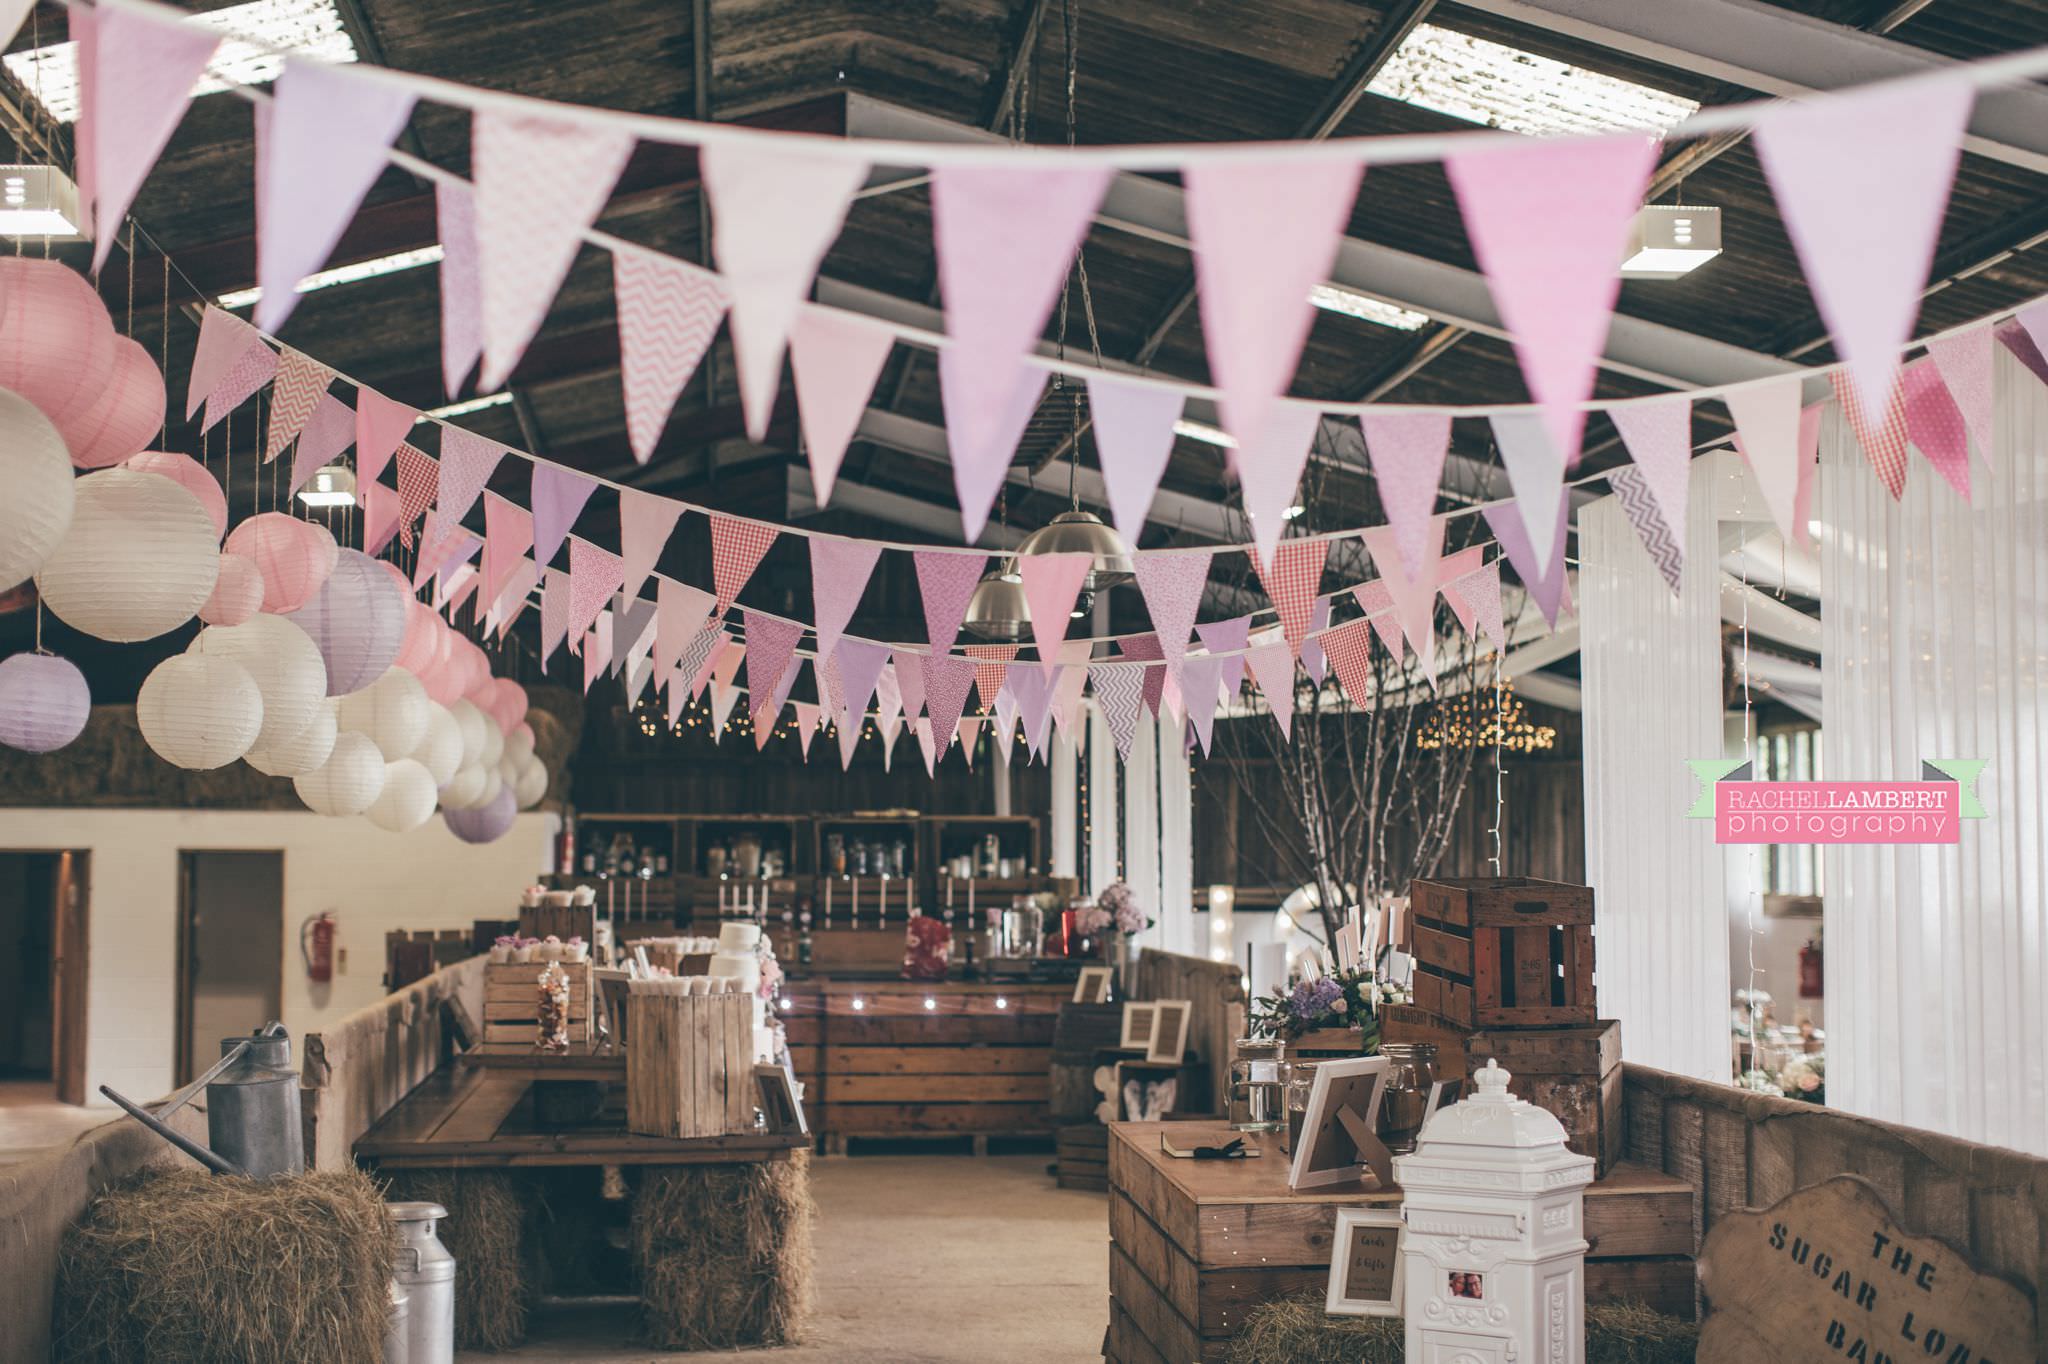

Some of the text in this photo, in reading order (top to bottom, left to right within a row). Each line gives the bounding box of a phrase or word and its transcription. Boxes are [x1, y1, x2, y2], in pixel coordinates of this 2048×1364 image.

[1768, 1222, 1998, 1364] SUGAR LOA
[1872, 1231, 1937, 1292] THE
